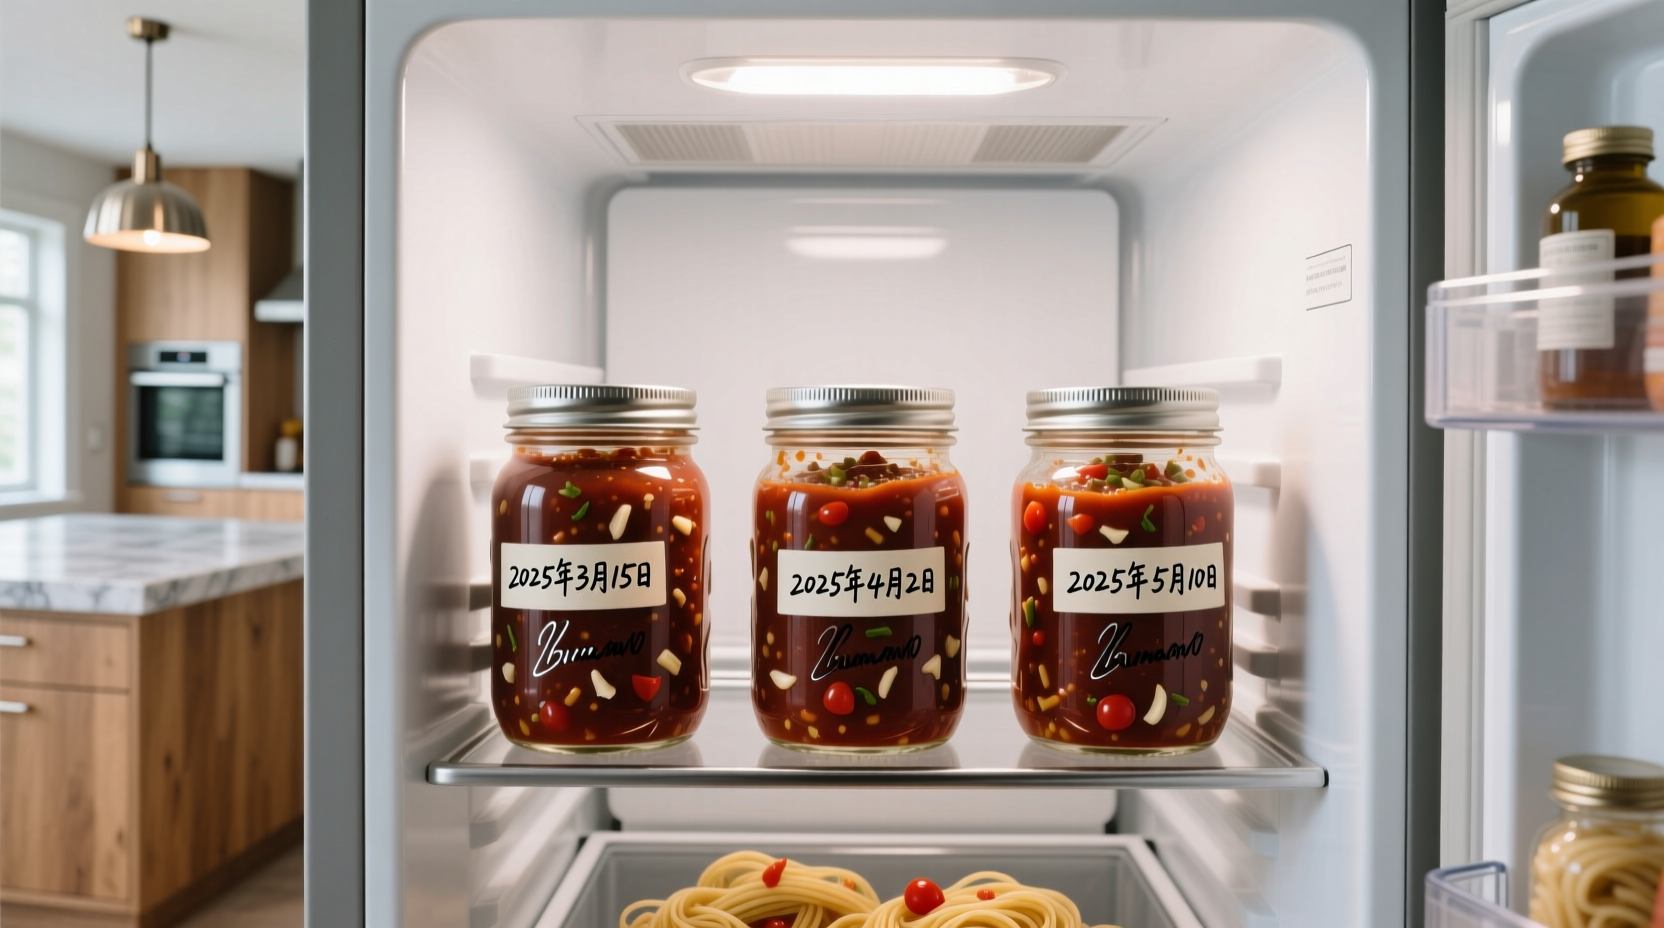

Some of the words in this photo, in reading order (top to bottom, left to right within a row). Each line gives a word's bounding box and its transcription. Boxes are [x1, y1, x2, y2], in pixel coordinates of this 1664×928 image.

[508, 558, 651, 597] 2025年3月15日
[790, 564, 934, 603] 2025年4月2日
[1066, 561, 1217, 600] 2025年5月10日
